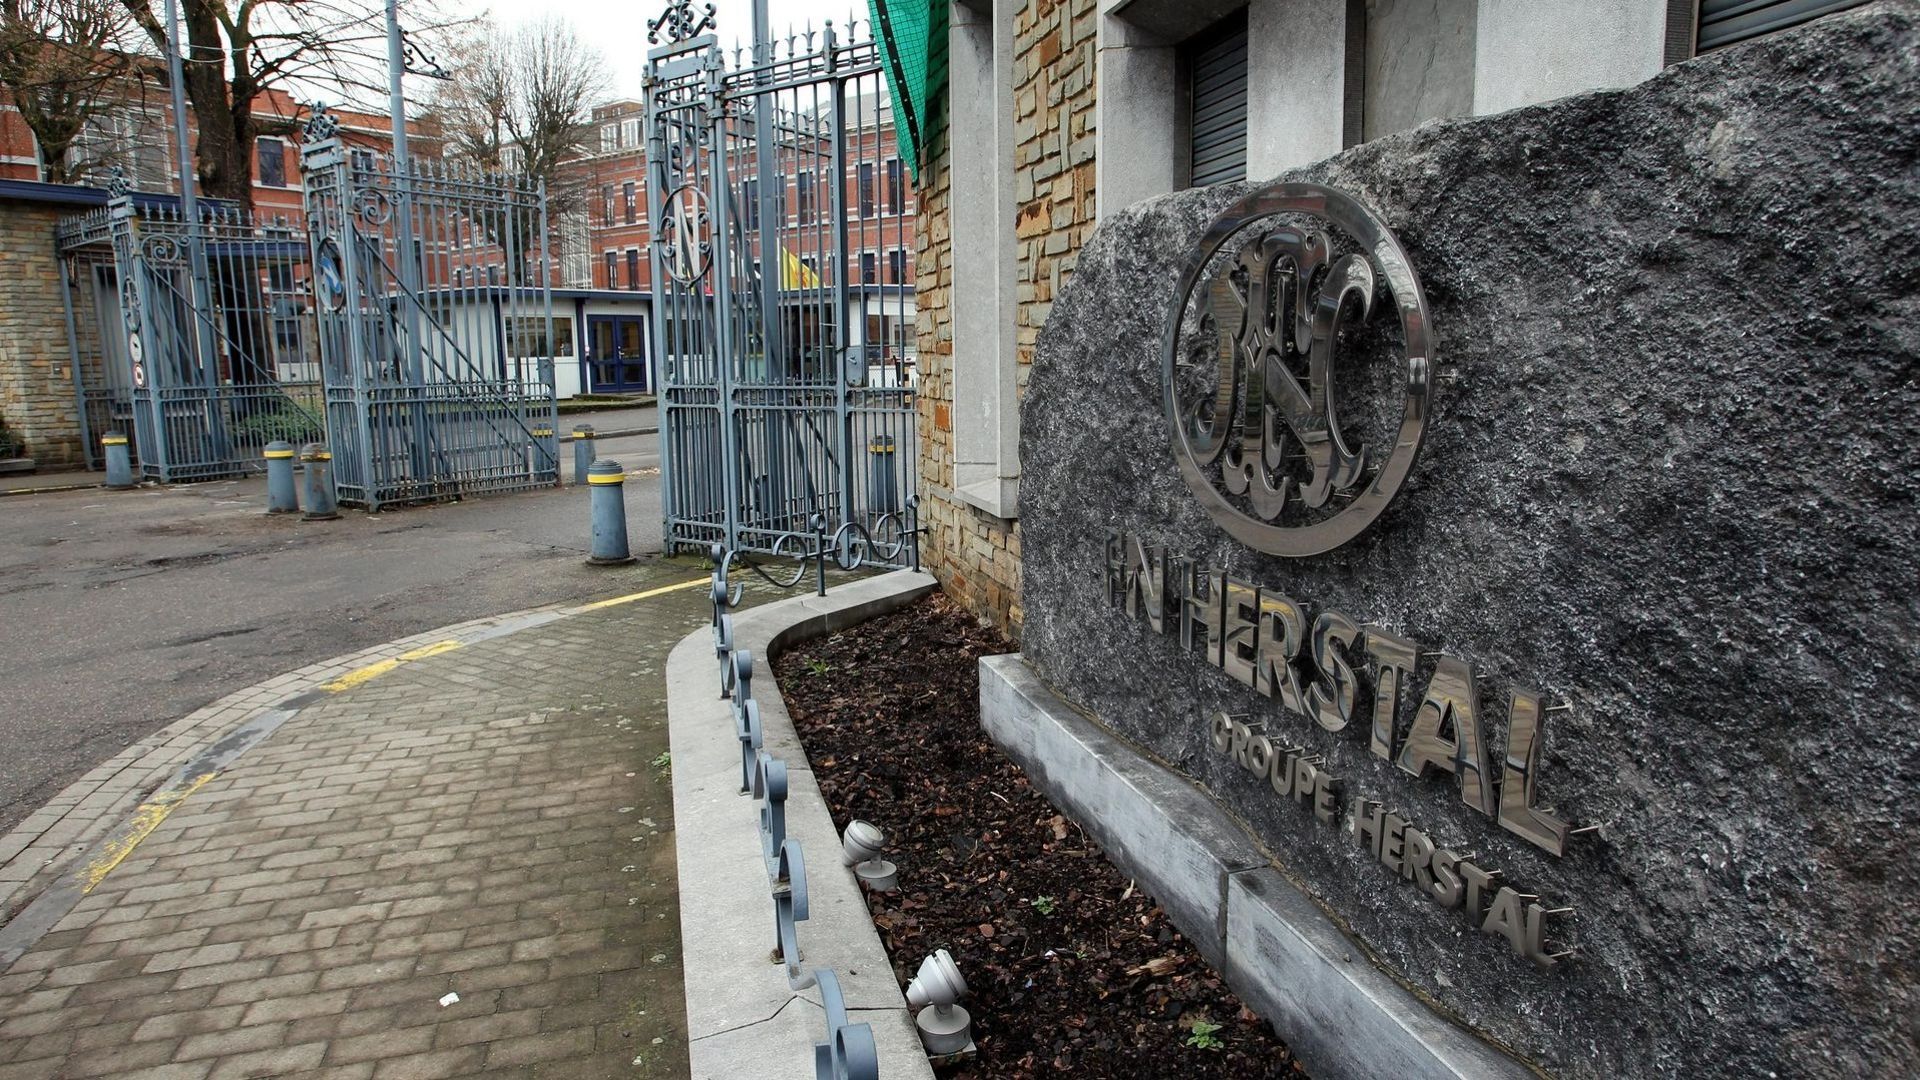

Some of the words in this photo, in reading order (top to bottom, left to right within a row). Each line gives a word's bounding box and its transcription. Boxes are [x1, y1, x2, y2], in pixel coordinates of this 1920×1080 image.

[1104, 525, 1167, 634] FN
[1180, 555, 1571, 858] HERSTAL
[1211, 711, 1341, 824] GROUPE
[1353, 796, 1557, 969] HERSTAL
